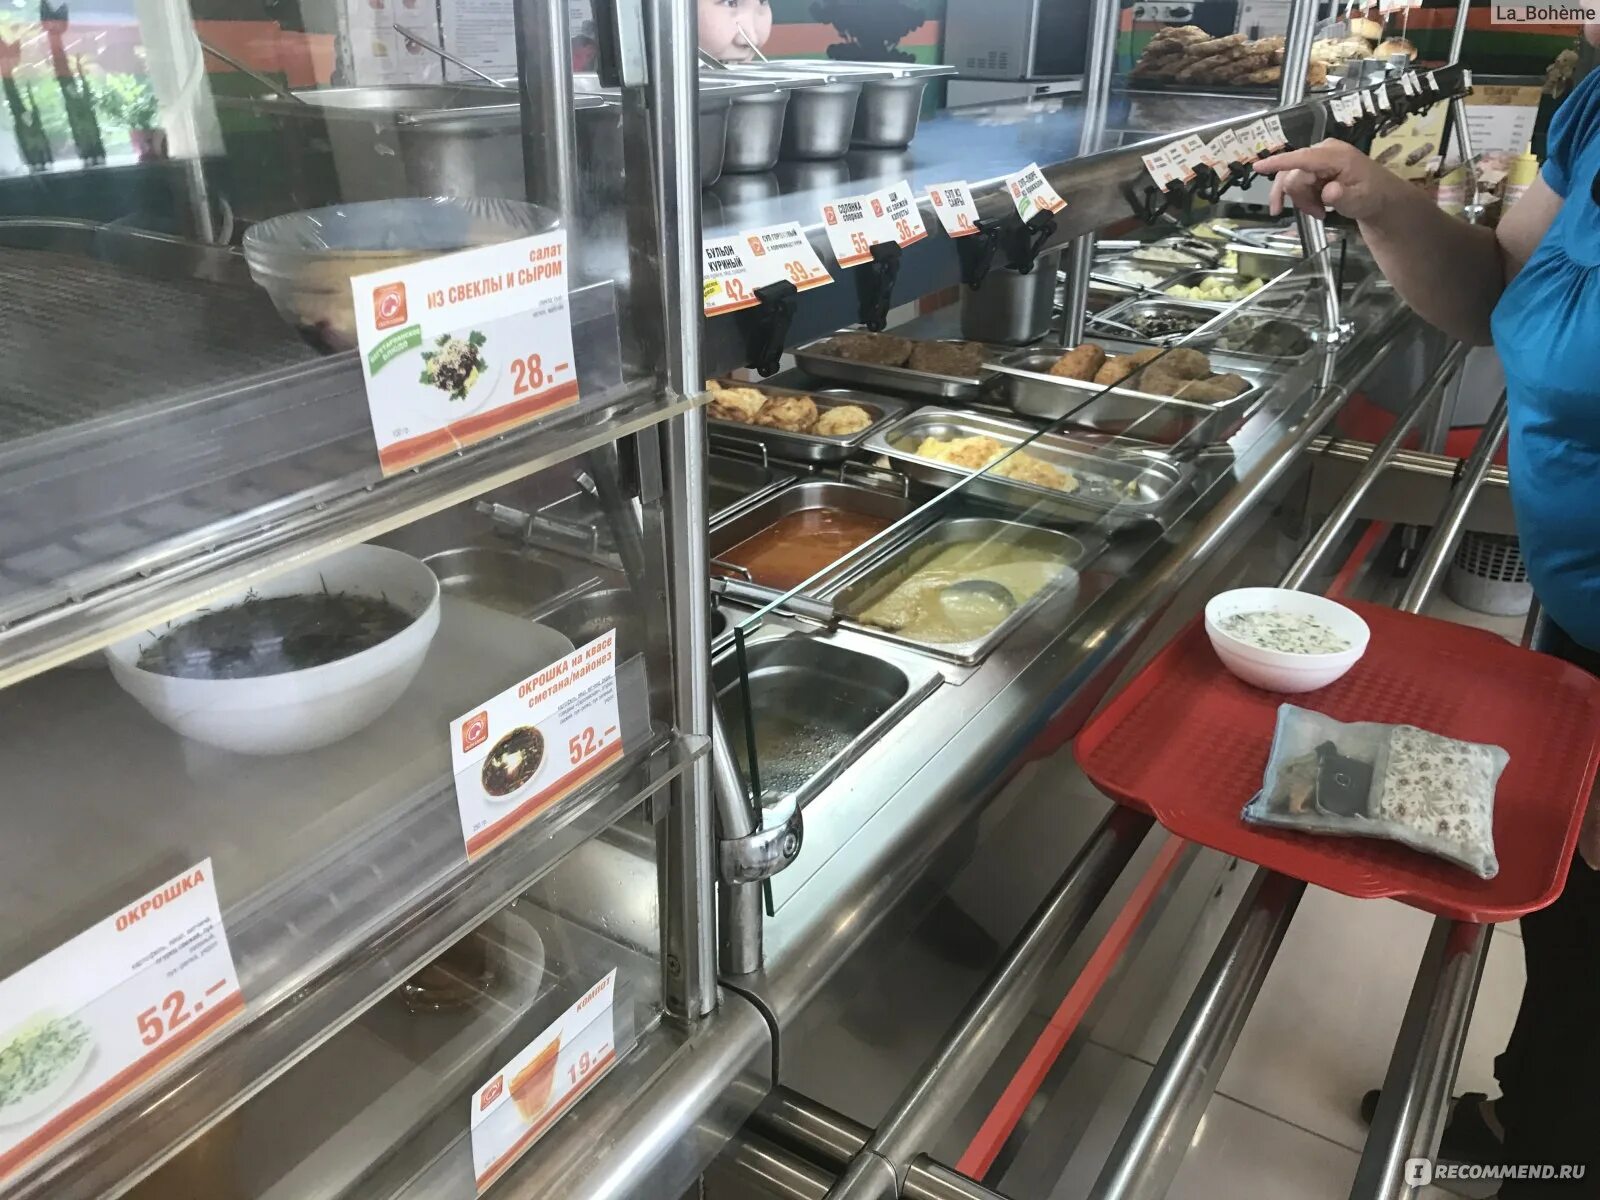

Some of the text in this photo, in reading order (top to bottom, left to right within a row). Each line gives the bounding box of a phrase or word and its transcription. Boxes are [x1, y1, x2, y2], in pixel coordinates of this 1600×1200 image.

[838, 201, 862, 214] СОЛЯНКА
[529, 244, 562, 262] салат
[705, 245, 735, 259] БУЛЬОН
[708, 256, 744, 273] КУРИНЫЙ
[427, 261, 562, 310] ИЗ СВЕКЛЫ И СЫРОМ
[518, 660, 569, 699] ОКРОШКА
[571, 655, 583, 668] на
[585, 636, 613, 663] квасе
[528, 651, 613, 709] сметана/майонез
[115, 869, 205, 932] ОКРОШКА
